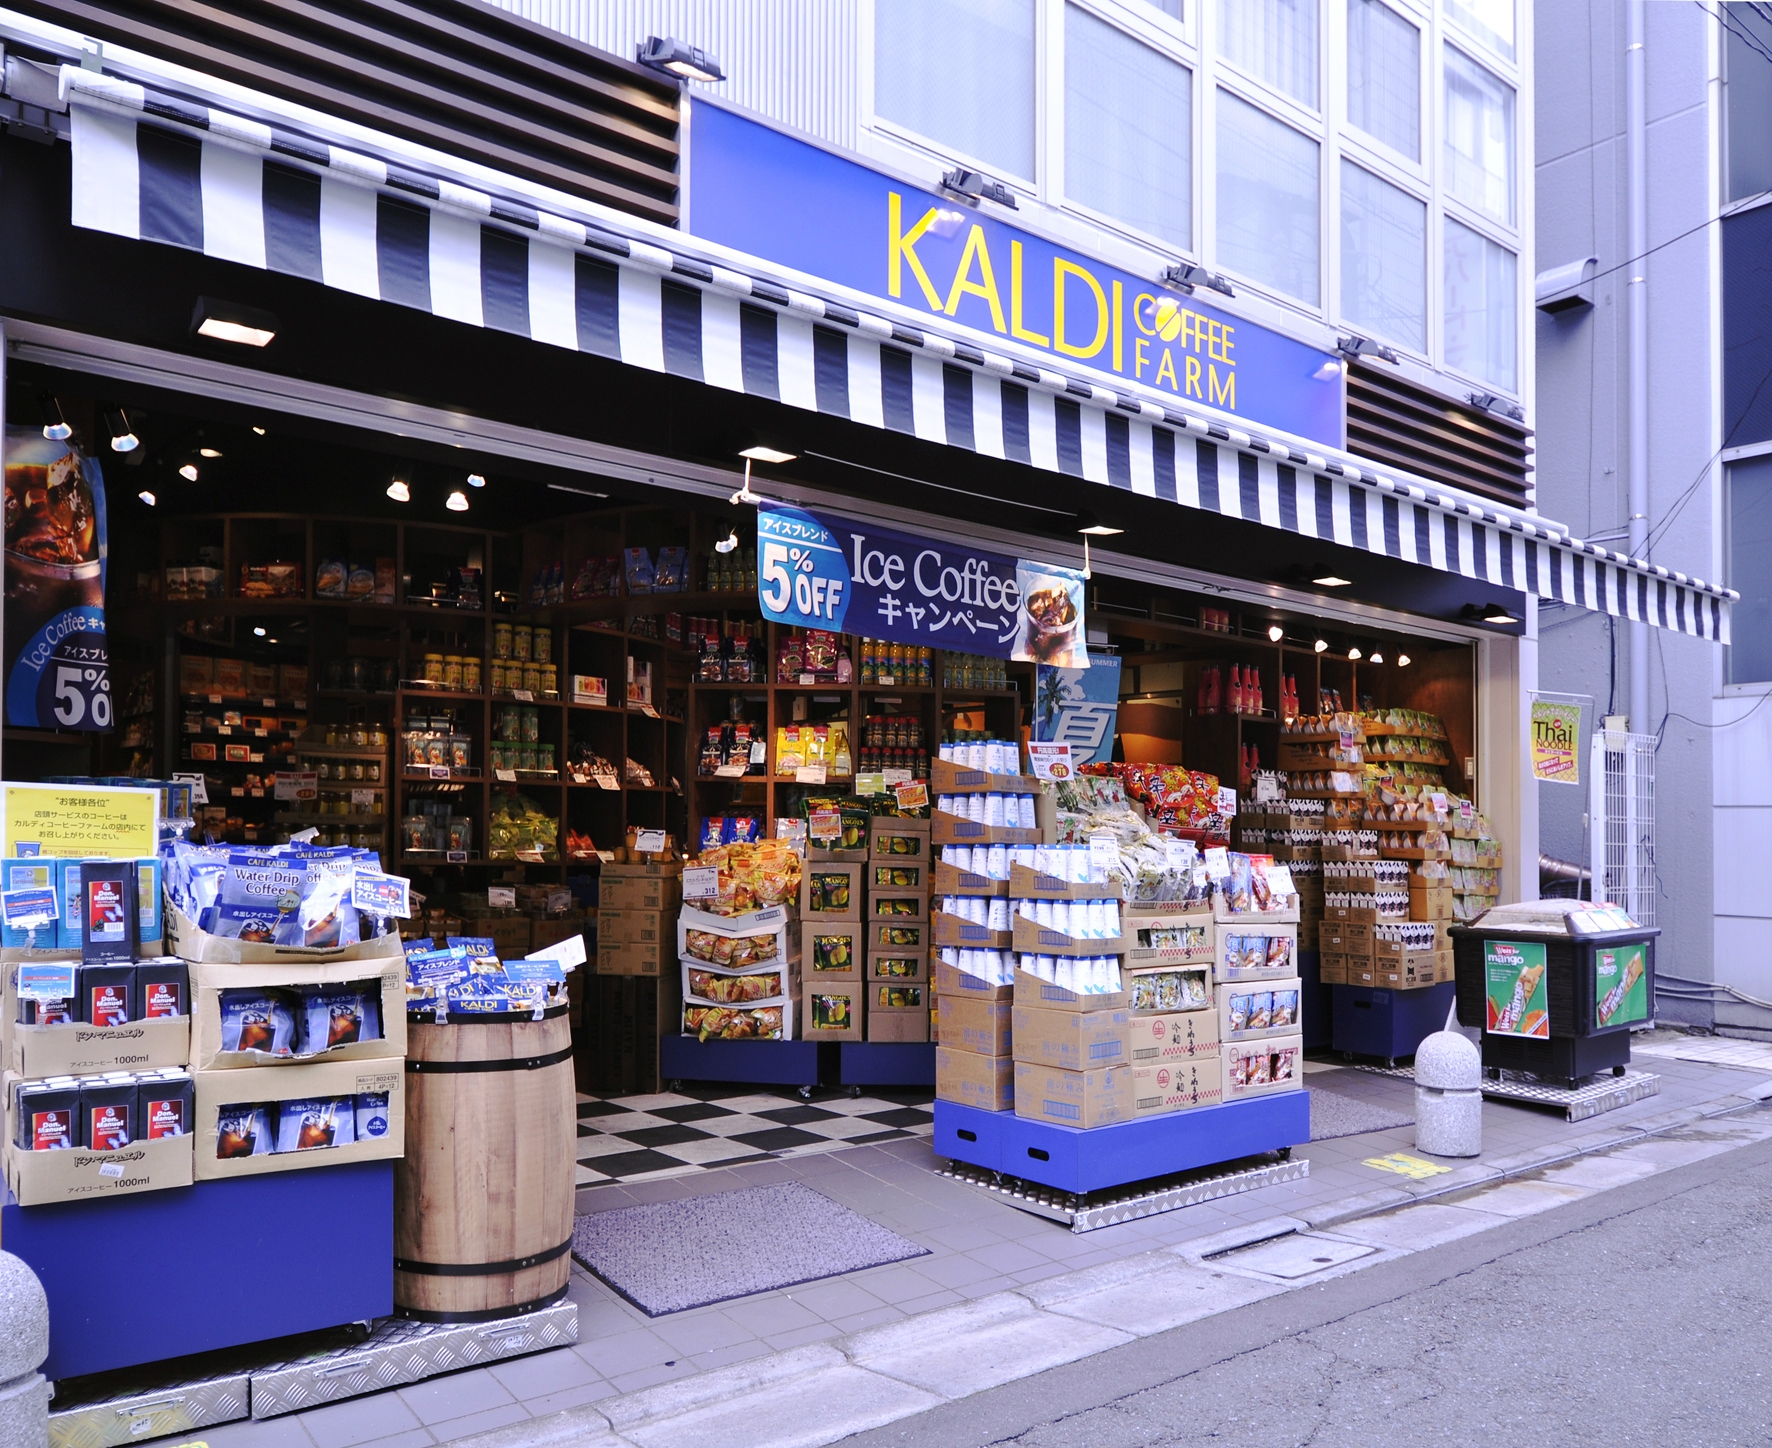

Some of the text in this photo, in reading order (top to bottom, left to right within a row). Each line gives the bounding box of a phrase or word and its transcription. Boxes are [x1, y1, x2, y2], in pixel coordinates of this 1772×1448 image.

[888, 191, 1123, 373] KALDI
[1134, 292, 1236, 366] COFFEE
[1135, 337, 1236, 410] FARM
[763, 517, 829, 542] アイスブレンド
[850, 533, 1020, 612] Ice Coffee
[762, 542, 843, 620] 5% OFF
[878, 593, 1020, 644] キャンペーン
[20, 643, 51, 672] Ice
[45, 614, 87, 647] Coffee
[64, 646, 108, 660] アイスブレ
[1533, 720, 1572, 743] Thai
[1536, 739, 1573, 751] NOODLE
[34, 810, 127, 821] 店頭サービスのコーヒーは
[14, 820, 146, 832] カルディコーヒーファームの店内にて
[38, 831, 120, 840] お召し上がりください。
[265, 859, 289, 868] KALDI
[235, 869, 299, 886] Water Drip
[245, 882, 286, 896] Coffee
[1488, 954, 1524, 966] mango
[1598, 965, 1617, 976] mango
[504, 984, 537, 998] KALD
[46, 1002, 67, 1010] anuel
[460, 1000, 498, 1009] KALDI
[1510, 981, 1524, 1022] mango
[70, 1054, 149, 1068] アイスコーヒー 1000ml
[375, 1075, 398, 1083] 802439
[96, 1120, 124, 1129] Manuel
[152, 1114, 179, 1122] Manuel
[37, 1126, 67, 1134] Manuel
[68, 1176, 150, 1193] アイスコーヒー 1000ml
